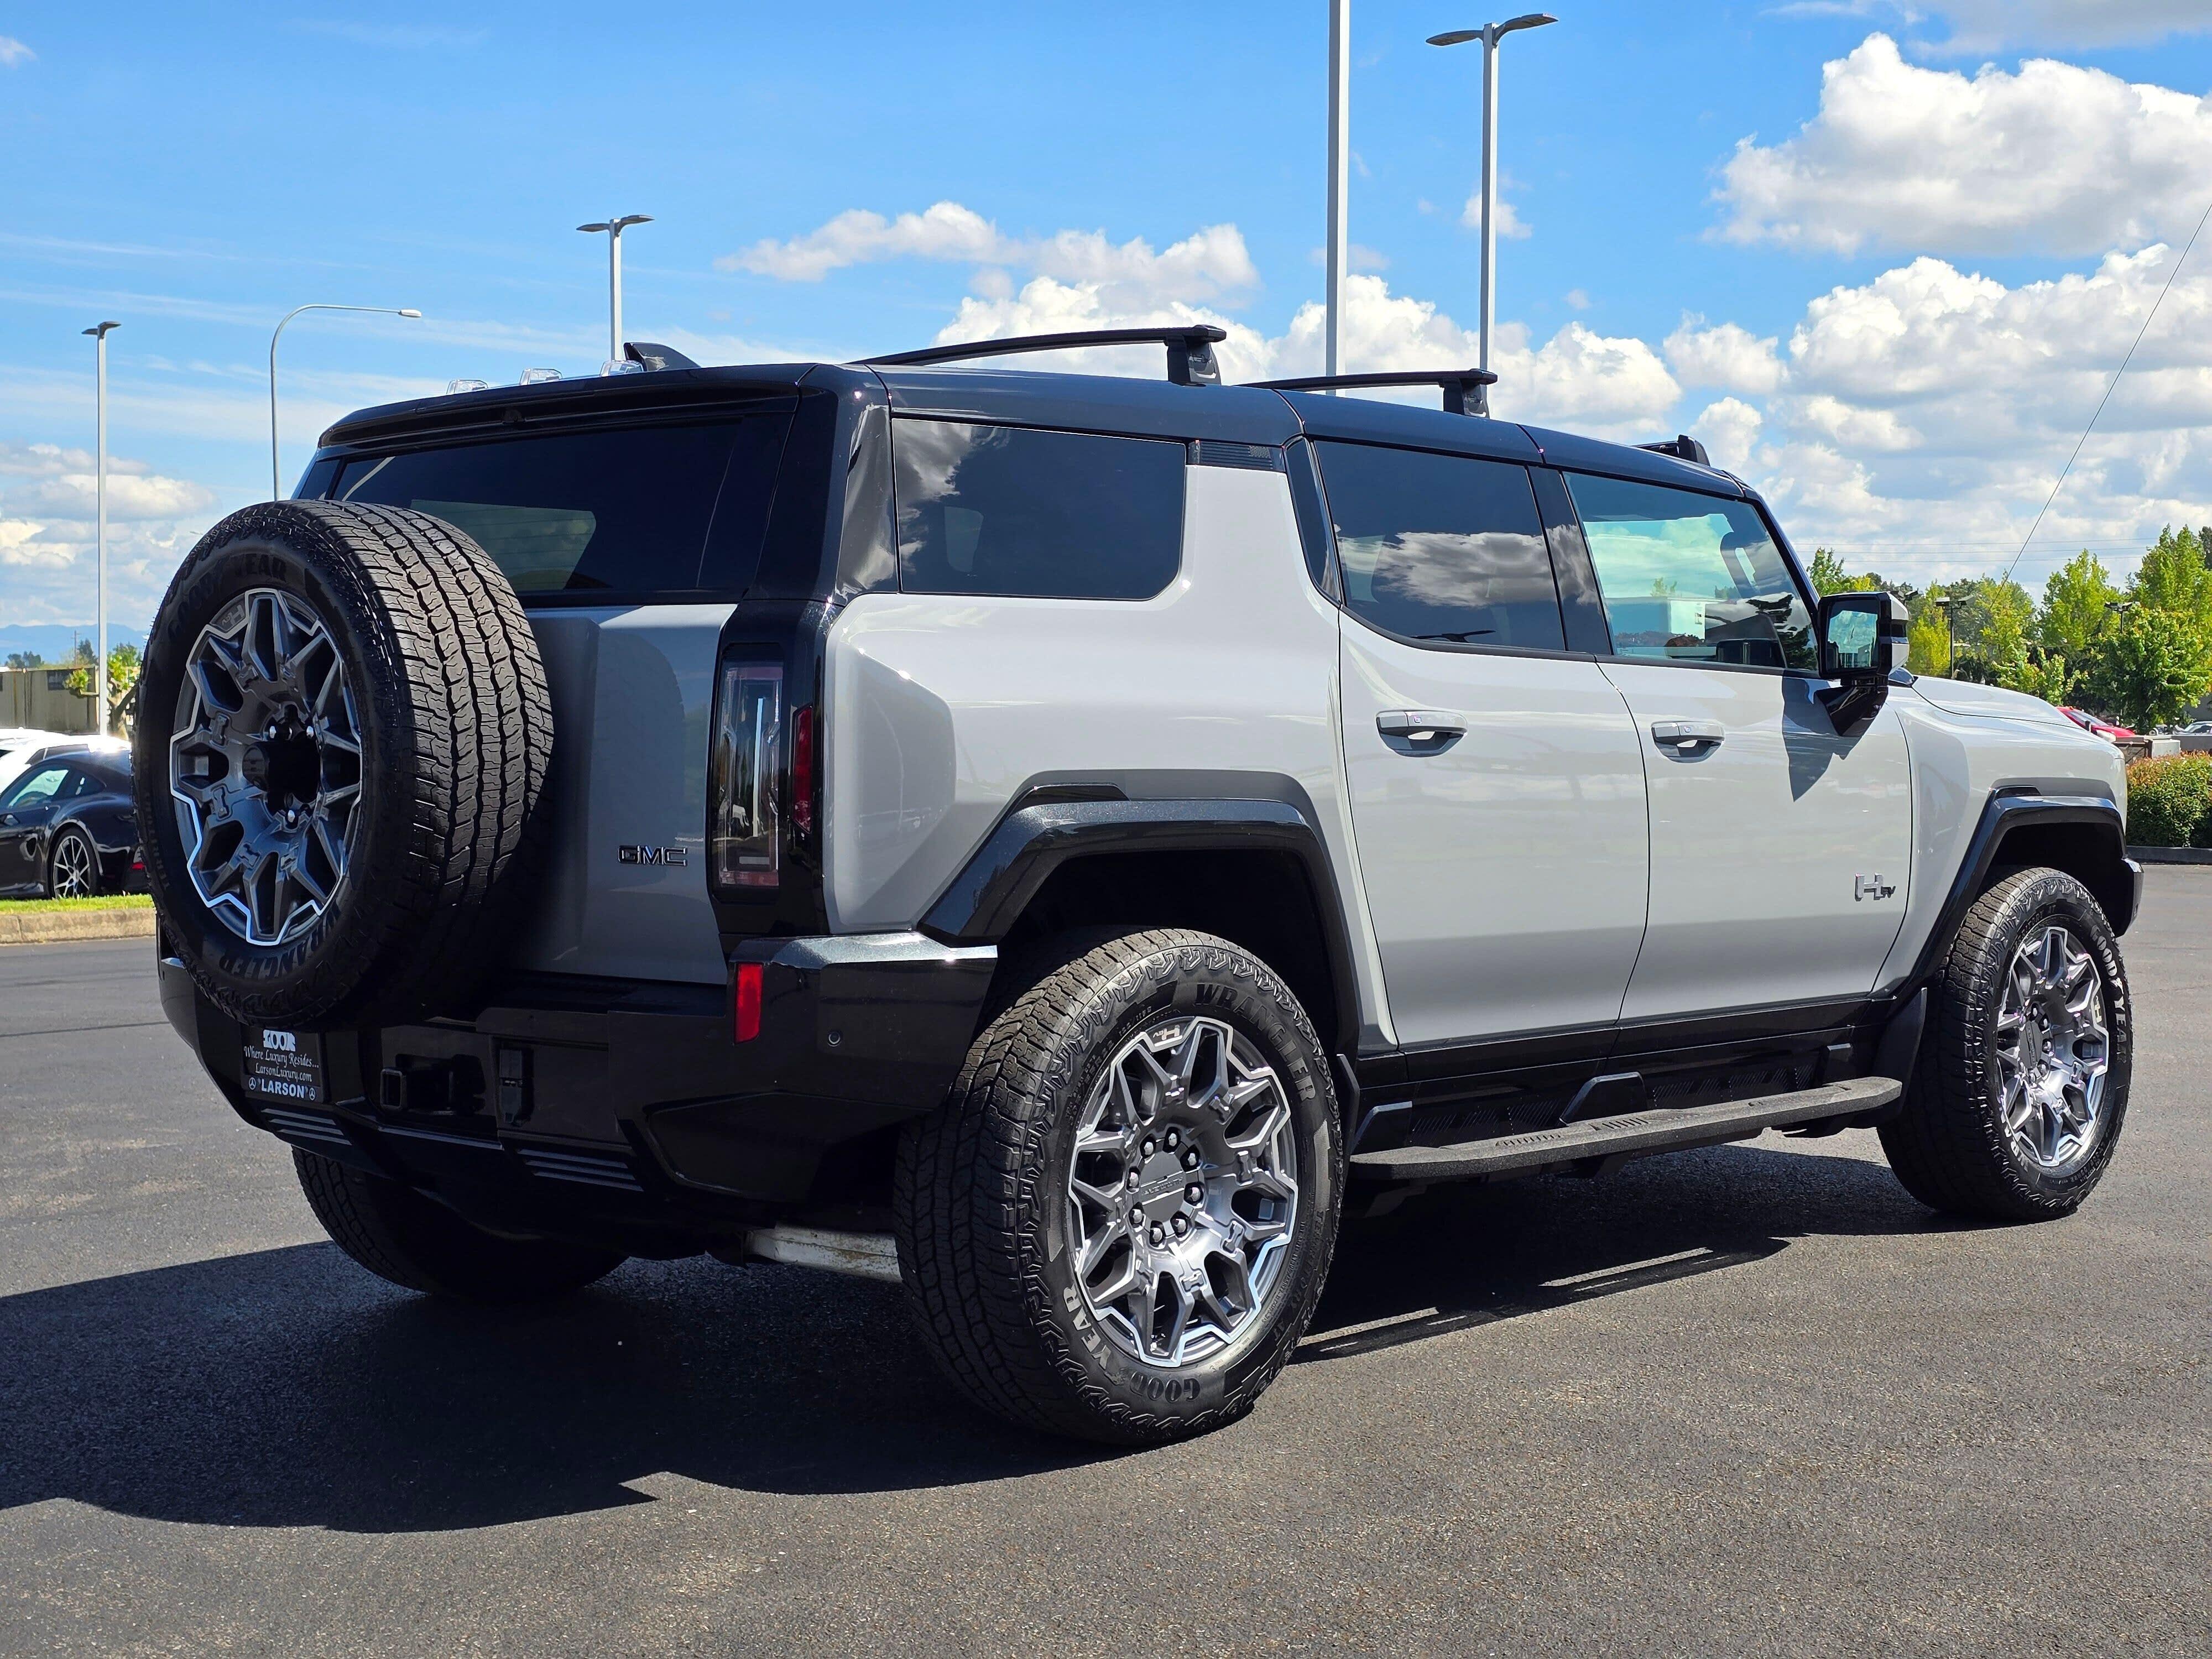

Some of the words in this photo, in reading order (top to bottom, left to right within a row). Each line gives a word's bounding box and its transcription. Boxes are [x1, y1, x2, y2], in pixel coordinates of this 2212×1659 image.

[618, 846, 687, 867] GMC
[1193, 983, 1317, 1102] WRANGLER
[243, 1045, 264, 1060] Where
[265, 1050, 288, 1068] Luxury
[255, 1062, 312, 1083] LarsonLuxury.com
